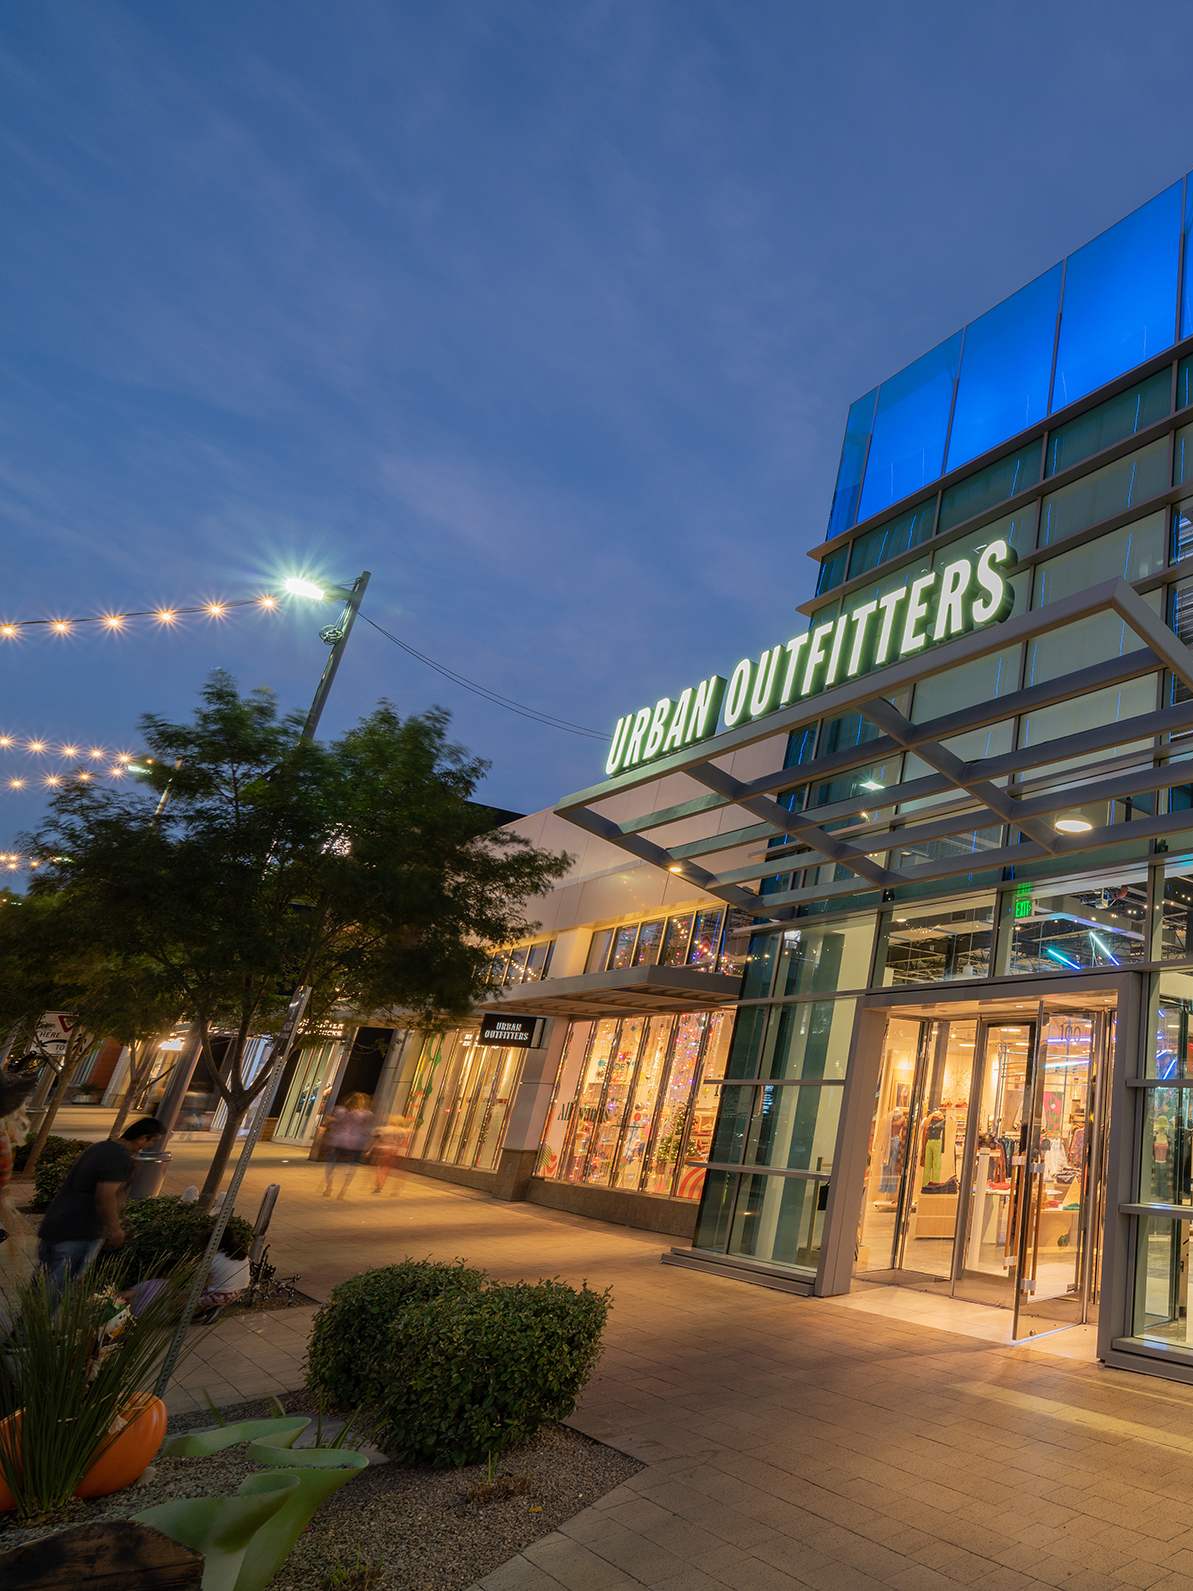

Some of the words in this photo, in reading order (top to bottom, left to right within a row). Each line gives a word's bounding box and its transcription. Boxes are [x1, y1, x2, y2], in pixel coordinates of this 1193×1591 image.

[604, 674, 724, 777] URBAN
[722, 539, 1014, 728] OUTFITTERS
[1015, 901, 1030, 918] EXIT
[496, 1022, 522, 1031] URBAN
[484, 1030, 529, 1040] OUTFITTERS
